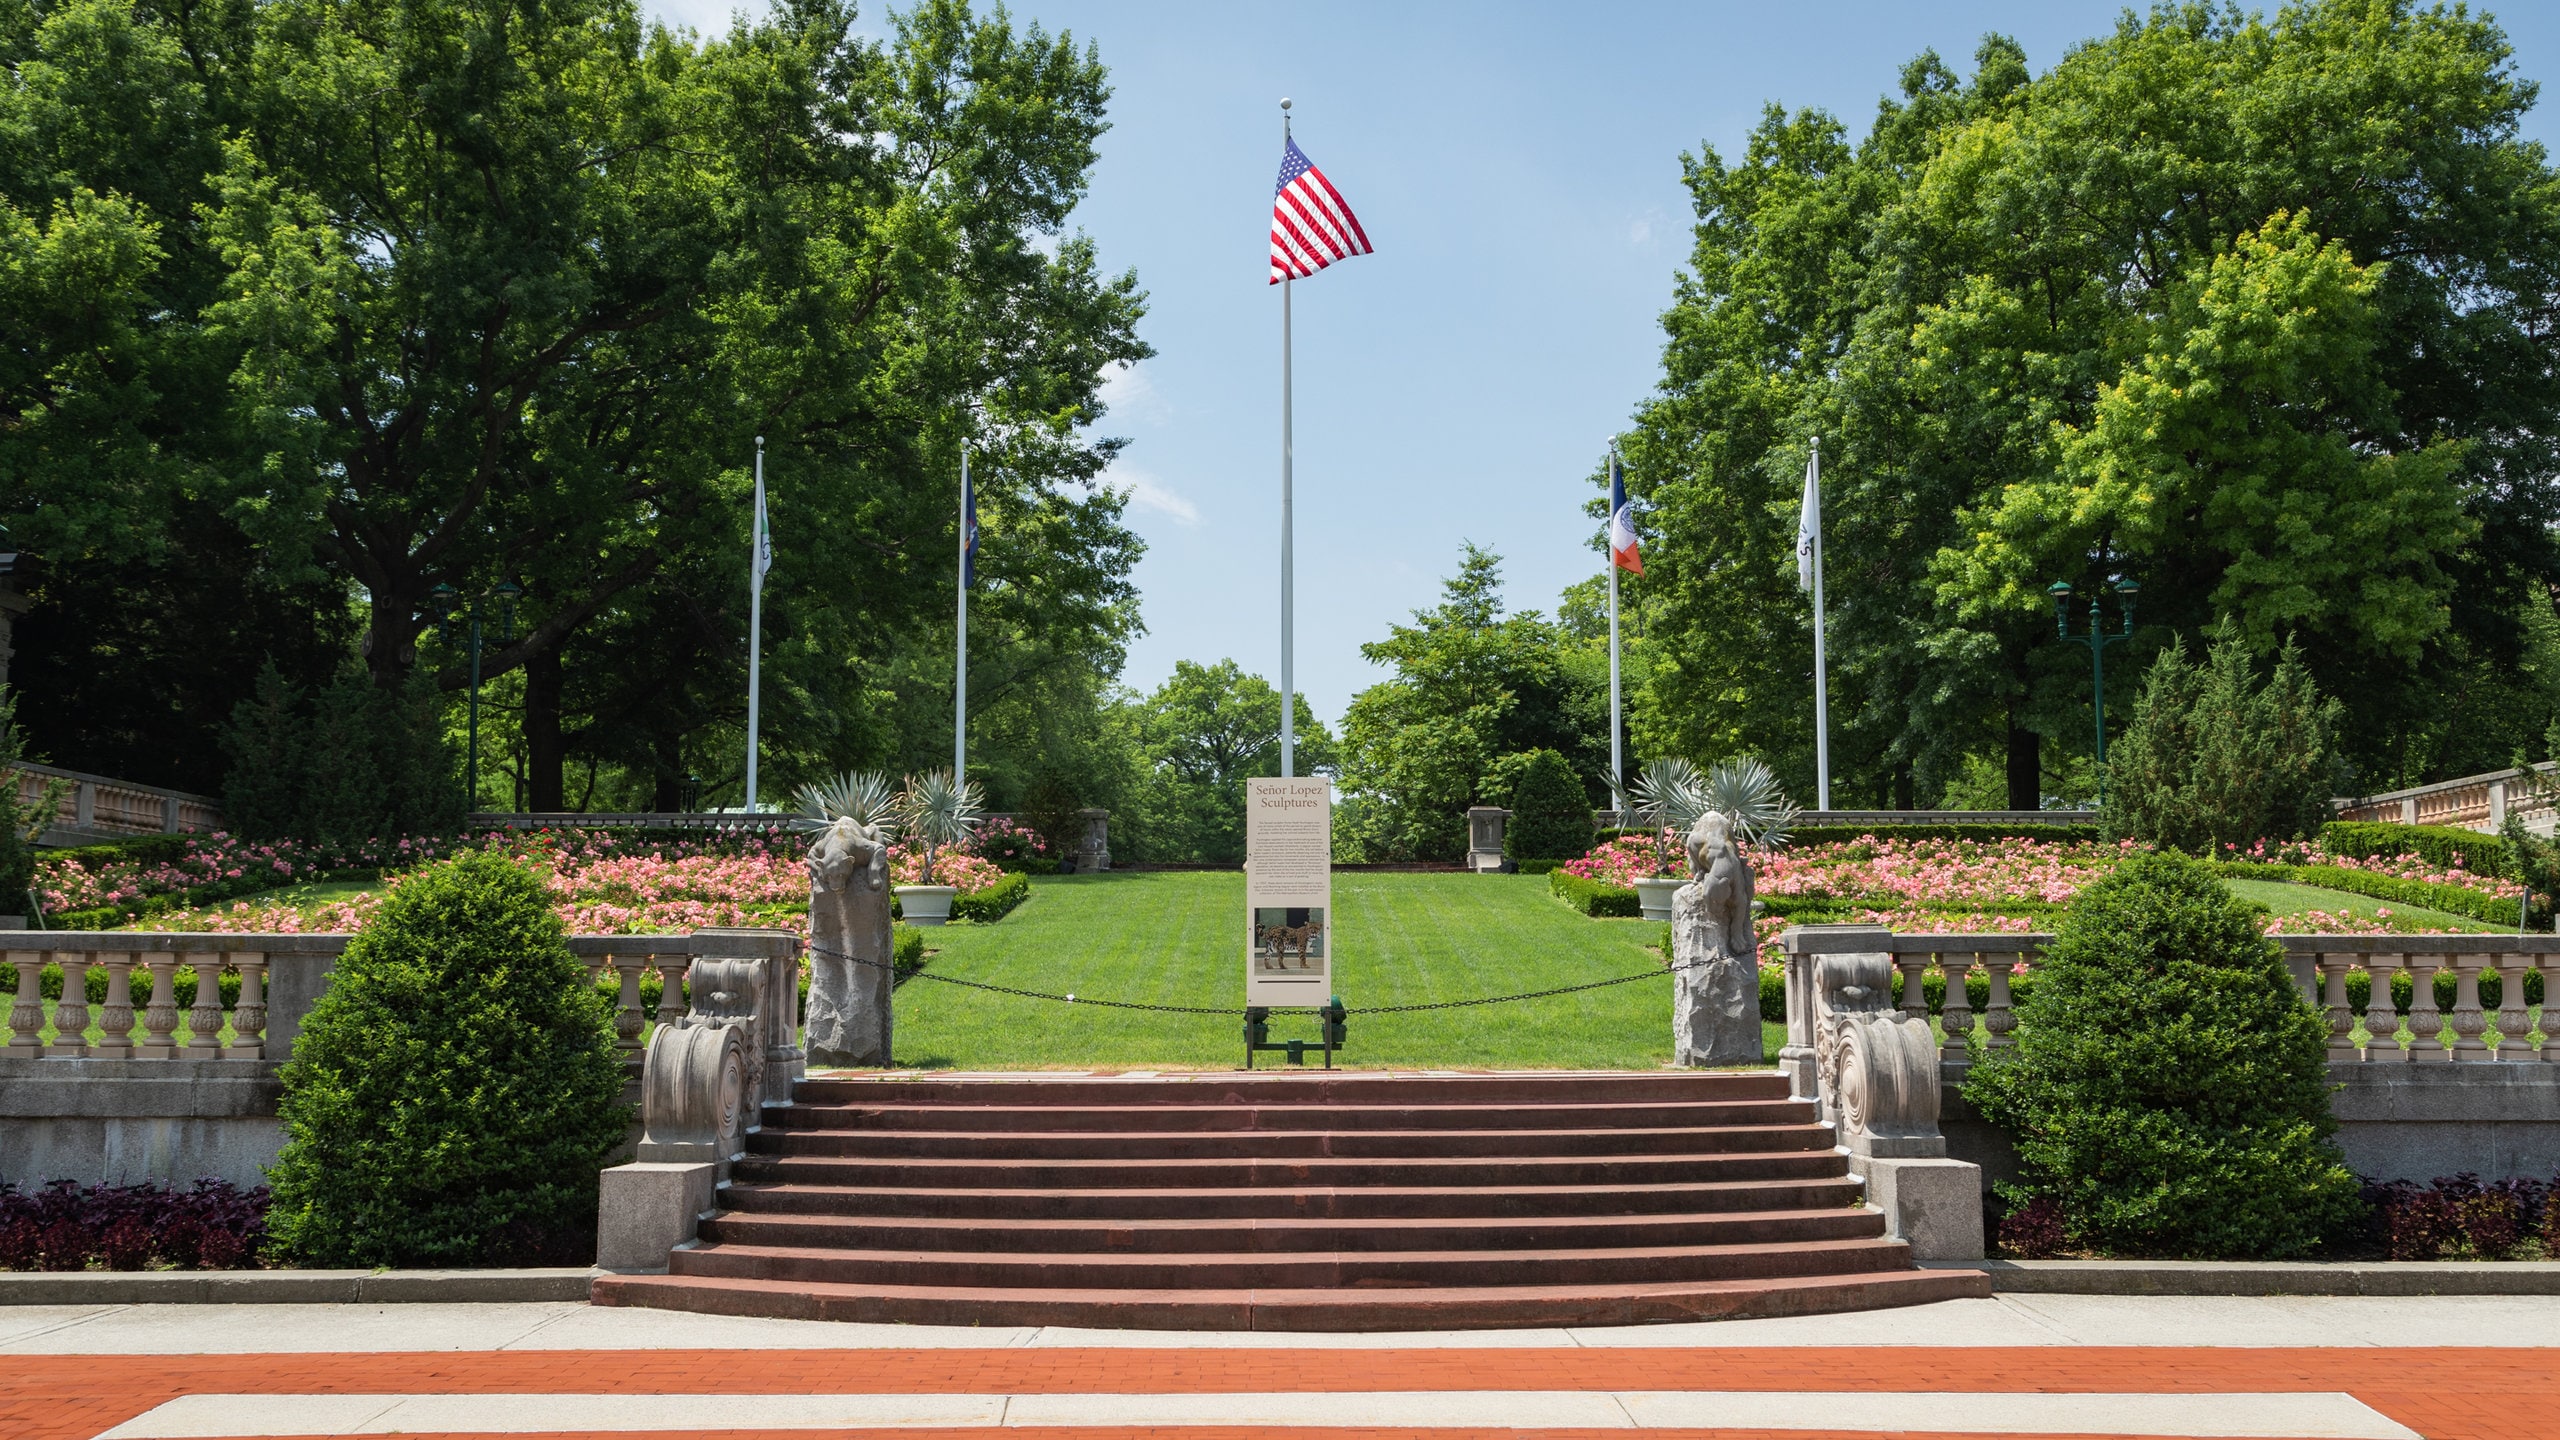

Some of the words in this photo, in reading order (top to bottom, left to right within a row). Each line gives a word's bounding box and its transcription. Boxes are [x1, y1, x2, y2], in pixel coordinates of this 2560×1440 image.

[1256, 785, 1287, 795] Señor
[1290, 785, 1323, 797] Lopez
[1261, 797, 1318, 810] Sculptures
